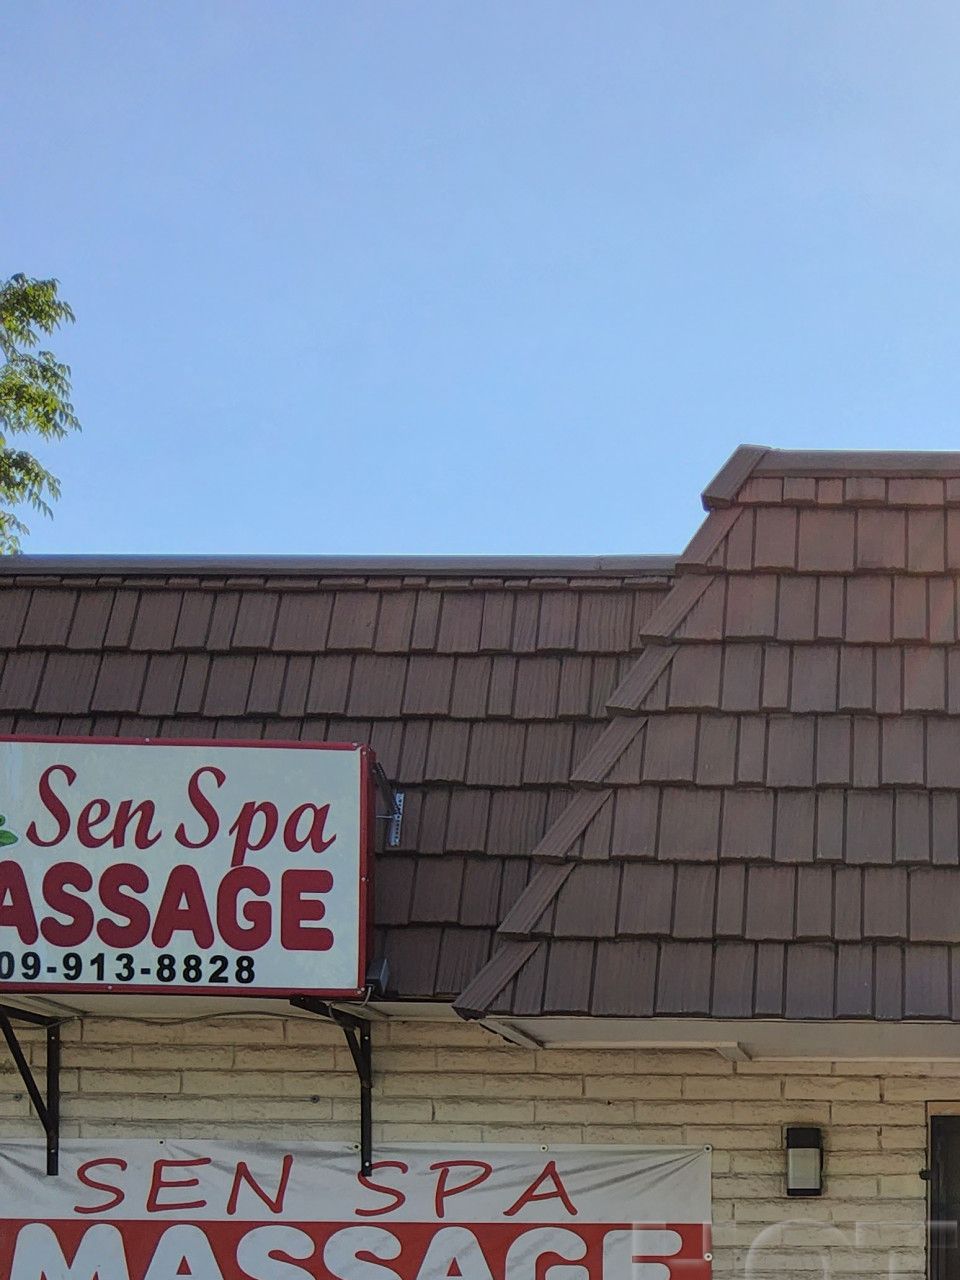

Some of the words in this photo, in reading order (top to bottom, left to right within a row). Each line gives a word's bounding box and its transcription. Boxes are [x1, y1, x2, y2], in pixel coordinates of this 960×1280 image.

[26, 764, 162, 849] Sen
[174, 766, 337, 867] Spa
[74, 1155, 293, 1214] SEN
[354, 1160, 578, 1218] SPA
